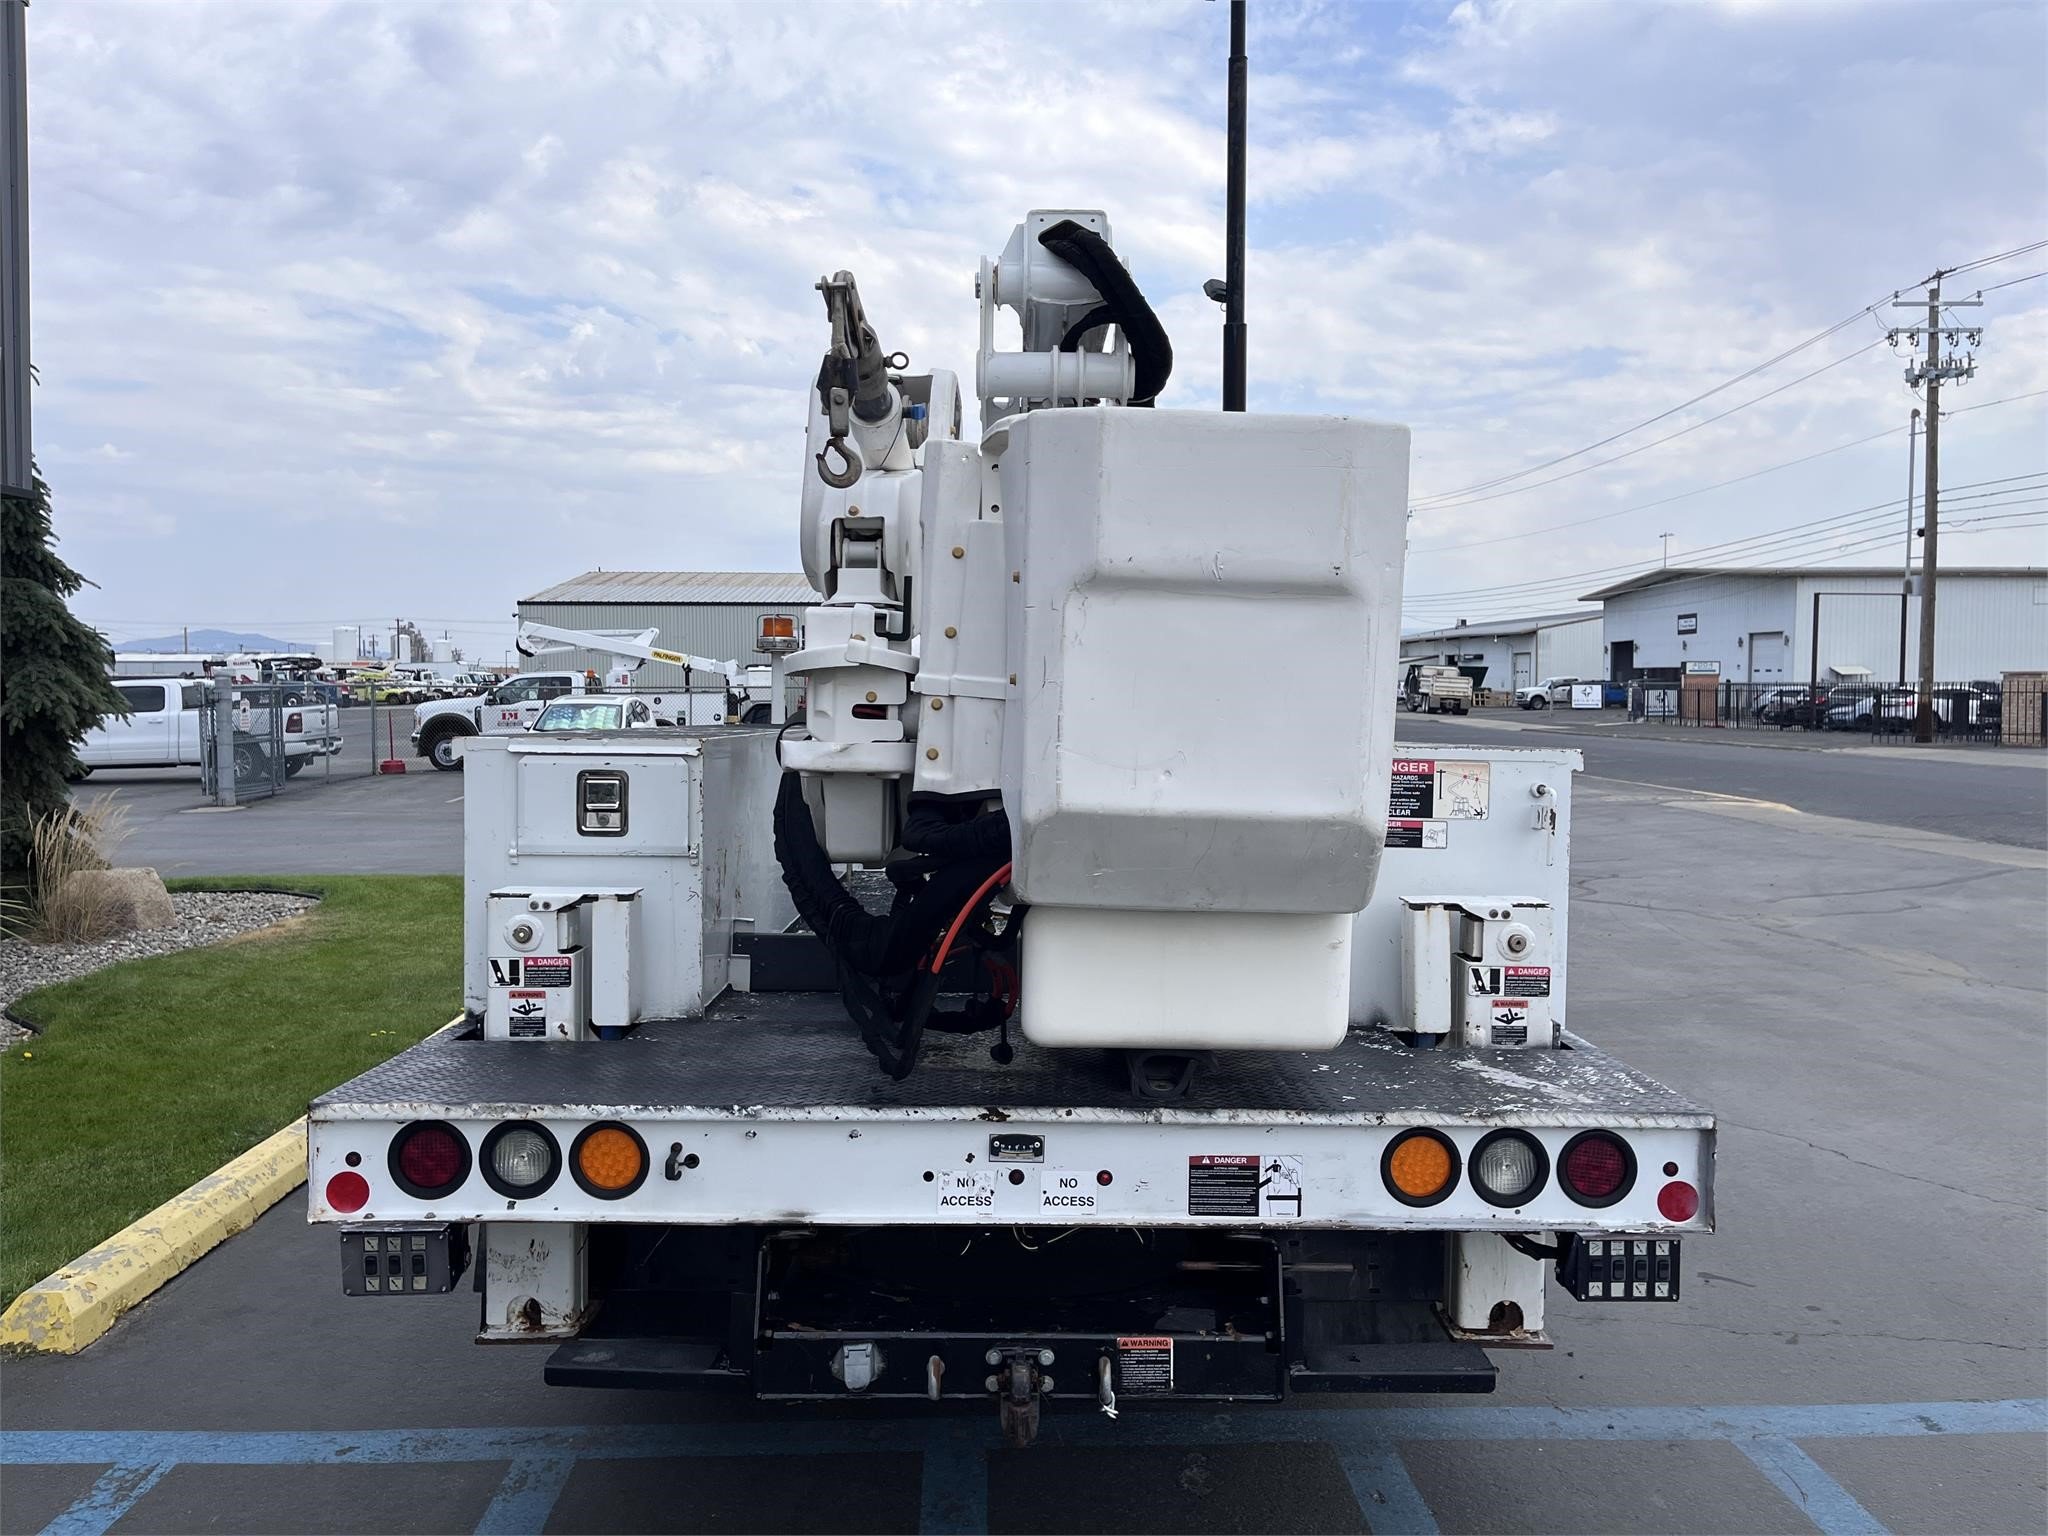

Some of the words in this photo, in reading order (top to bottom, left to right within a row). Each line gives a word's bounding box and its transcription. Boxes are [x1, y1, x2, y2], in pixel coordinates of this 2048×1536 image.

[956, 1177, 976, 1188] NO
[1059, 1178, 1078, 1188] NO
[940, 1195, 992, 1206] ACCESS
[1043, 1196, 1095, 1207] ACCESS
[1130, 1339, 1168, 1347] WARNING
